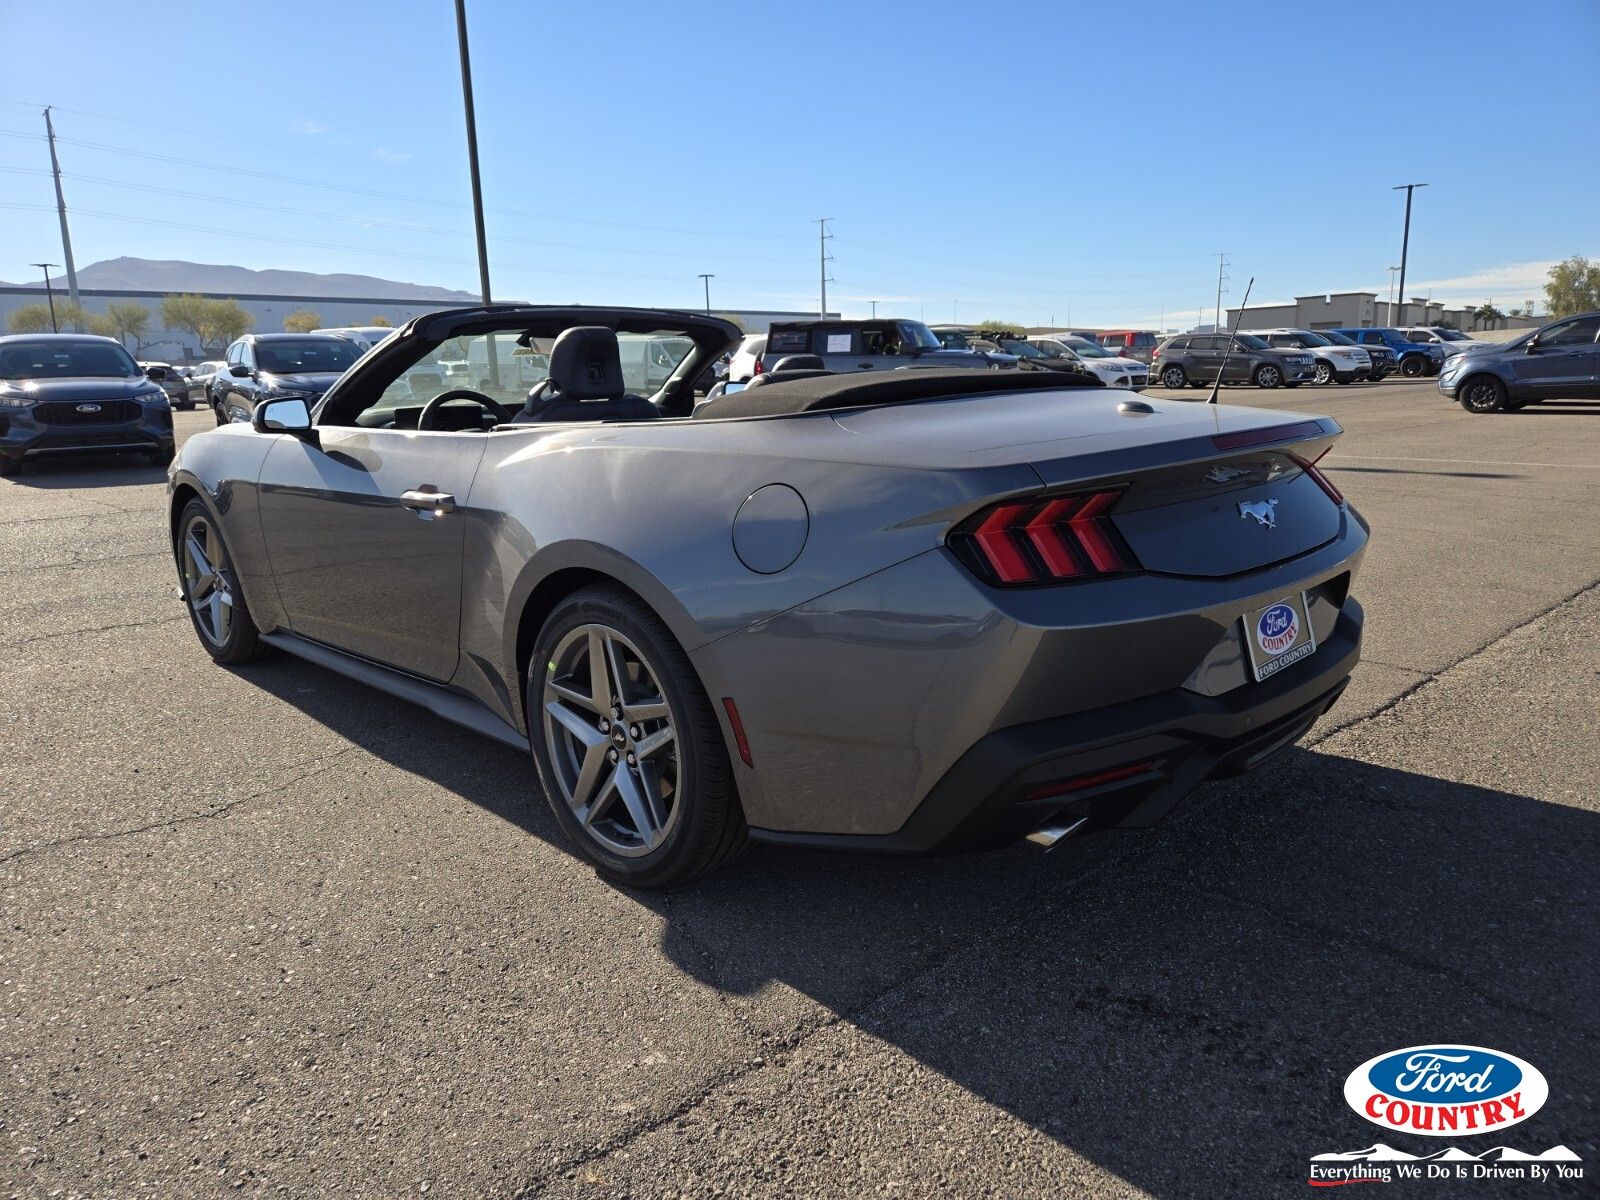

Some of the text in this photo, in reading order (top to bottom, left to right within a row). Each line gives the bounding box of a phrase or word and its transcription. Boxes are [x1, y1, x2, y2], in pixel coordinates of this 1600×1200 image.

[1266, 609, 1288, 635] Ford
[1262, 623, 1298, 650] COUNTRY
[1259, 643, 1313, 678] FORD COUNTRY
